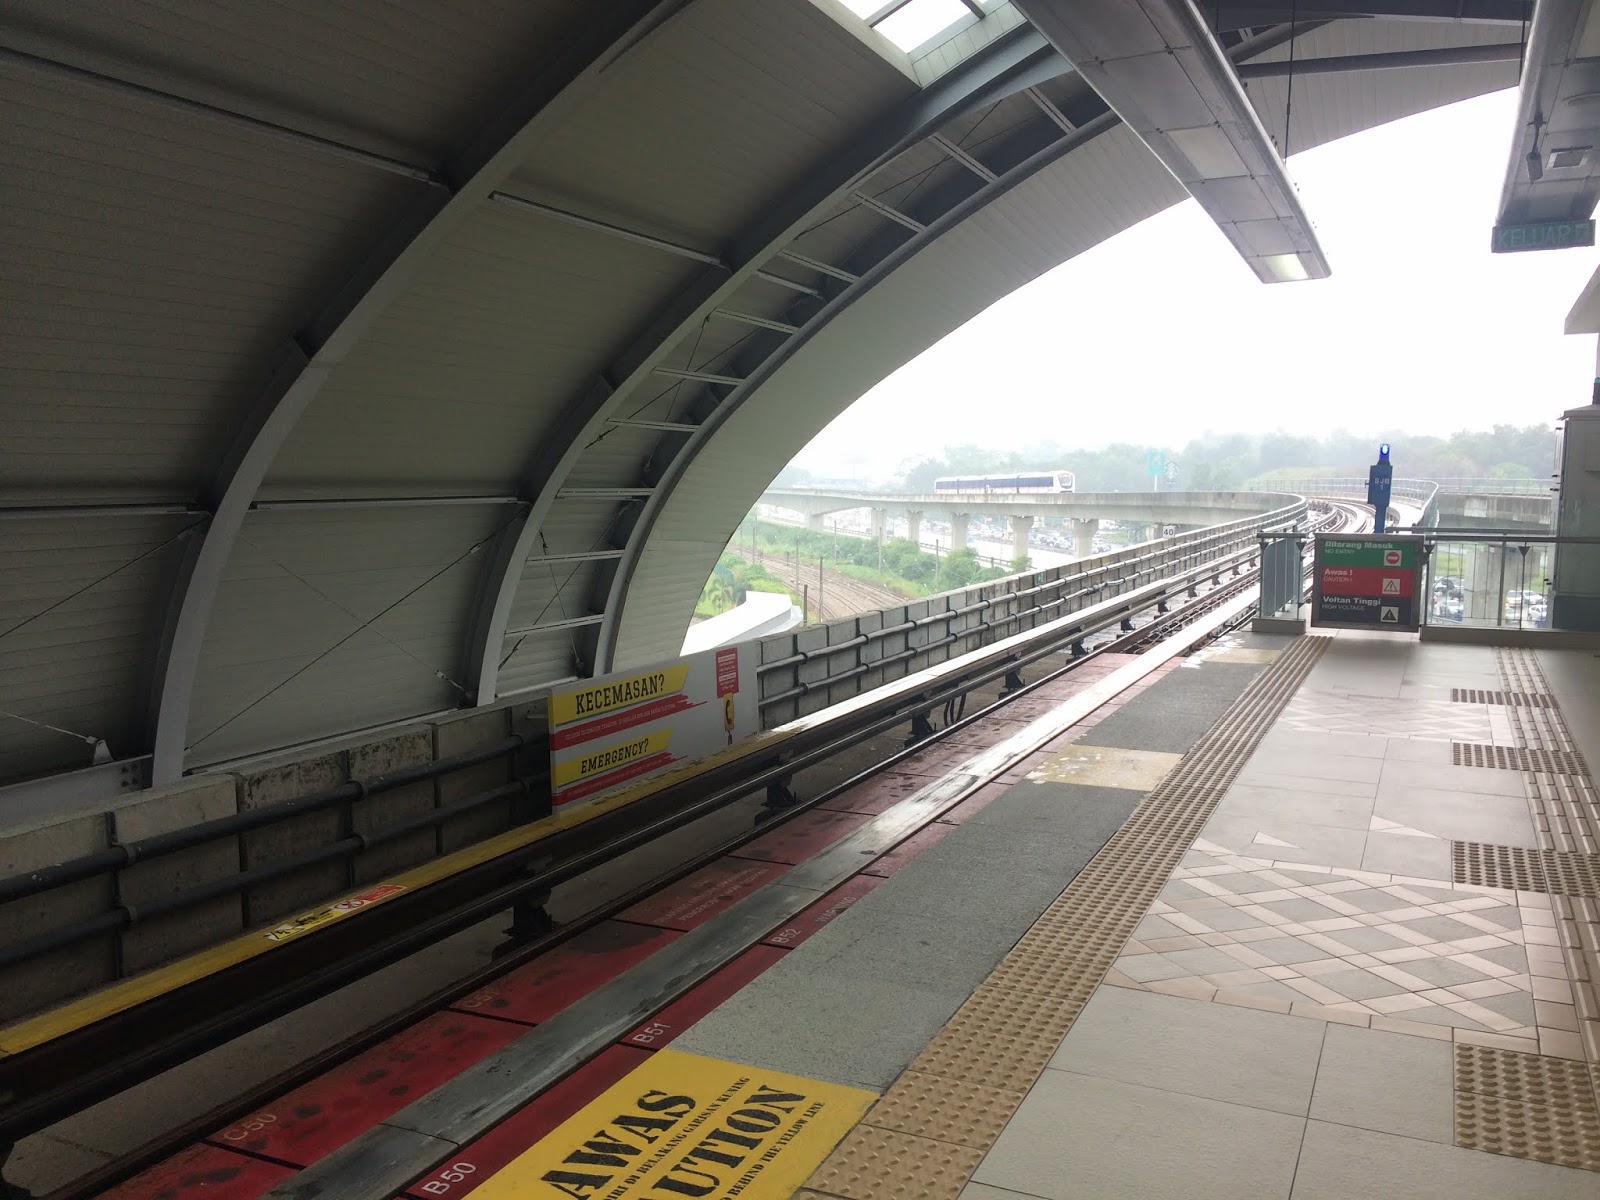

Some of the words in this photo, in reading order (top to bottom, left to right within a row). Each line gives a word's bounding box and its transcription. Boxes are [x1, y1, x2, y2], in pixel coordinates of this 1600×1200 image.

[1163, 528, 1174, 536] 40
[1324, 540, 1362, 549] Dilarang
[1323, 596, 1351, 604] Voltan
[1353, 598, 1381, 606] Tinggi
[575, 673, 665, 715] KECEMASAN?
[580, 738, 649, 774] EMERGENCY?
[771, 928, 802, 944] B52
[632, 1021, 671, 1044] B51
[223, 1113, 278, 1141] C50
[623, 1174, 641, 1185] DI
[636, 1133, 687, 1174] BELAKANG
[682, 1102, 722, 1134] GARISAN
[716, 1076, 750, 1103] KUNING
[540, 1089, 697, 1200] AWAS
[727, 1163, 765, 1196] BEHIND
[760, 1145, 782, 1162] THE
[775, 1118, 808, 1146] YELLOW
[803, 1101, 826, 1118] LINE
[421, 1162, 477, 1195] B50
